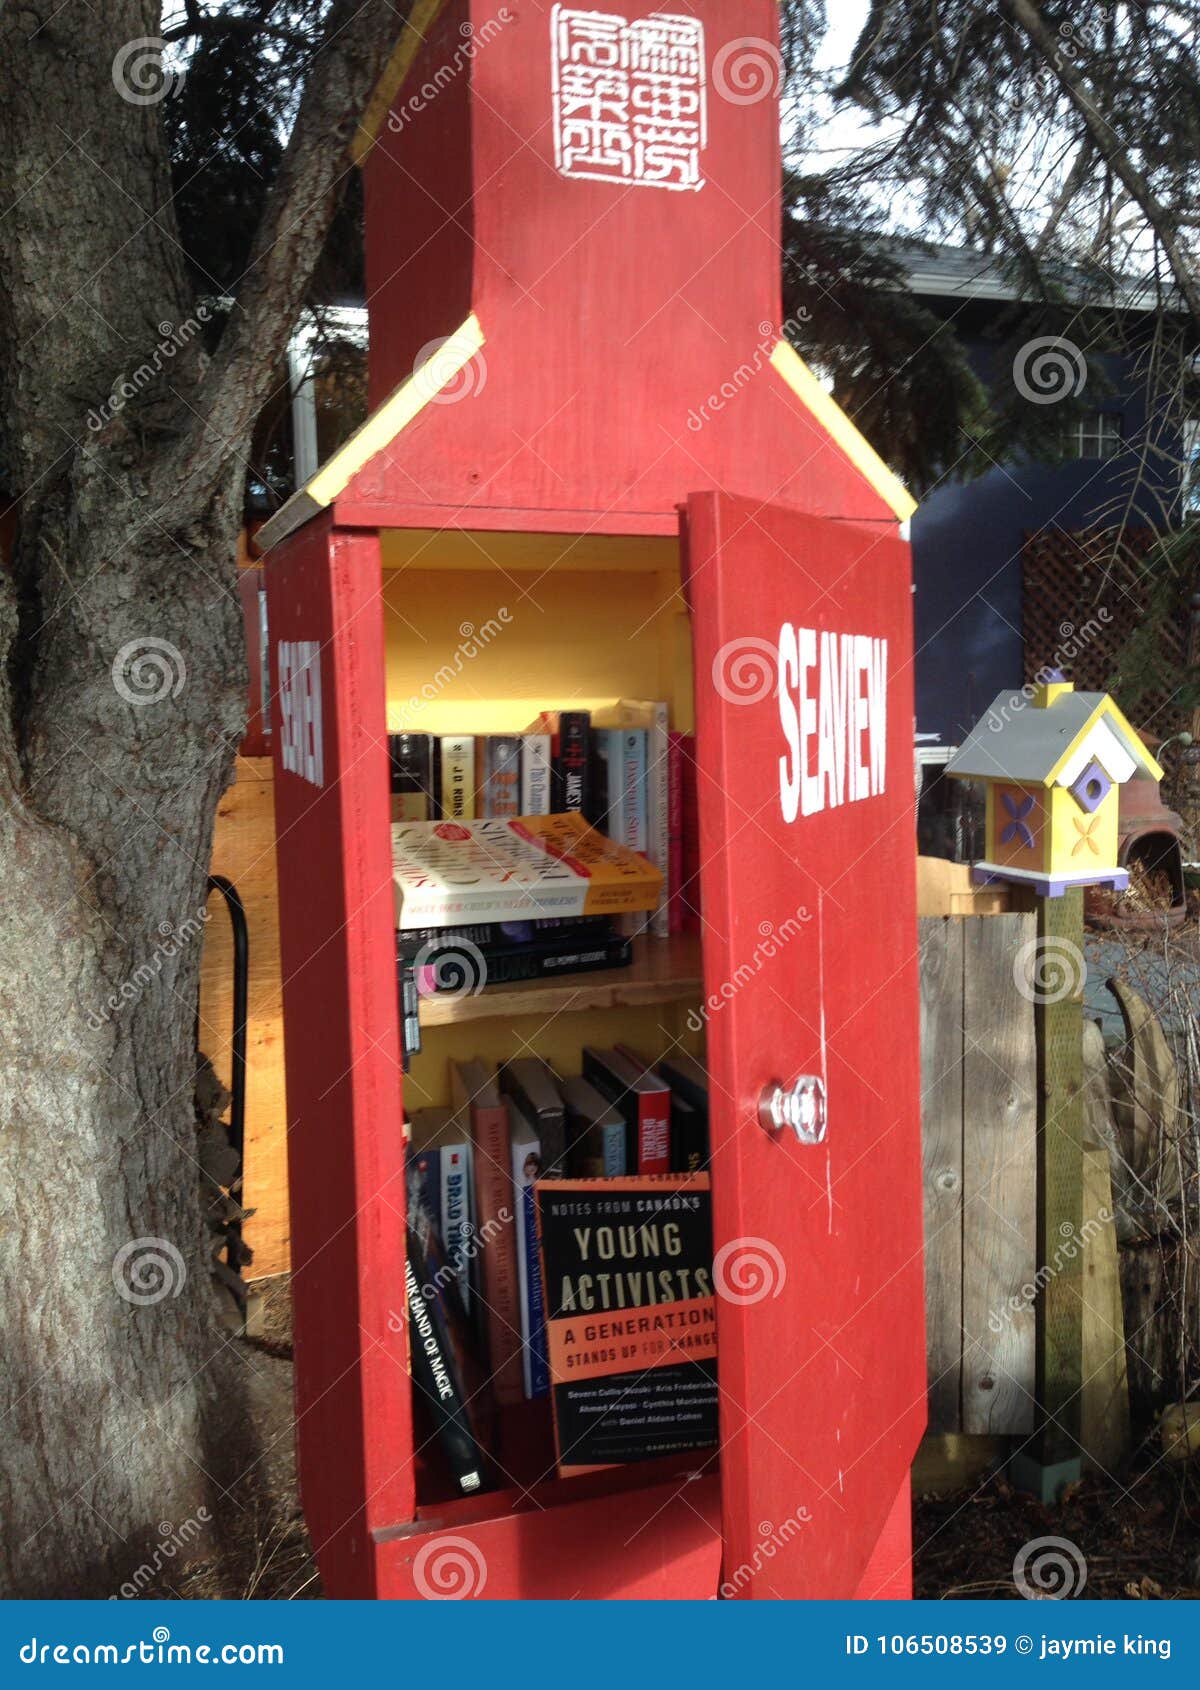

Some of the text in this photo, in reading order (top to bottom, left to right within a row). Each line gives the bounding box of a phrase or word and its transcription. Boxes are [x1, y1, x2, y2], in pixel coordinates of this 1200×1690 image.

[778, 622, 888, 824] SEAVIEW
[566, 771, 582, 804] JAMES
[447, 1173, 464, 1220] BRAD
[551, 1197, 701, 1216] NOTES FROM CANADA'S
[573, 1223, 682, 1261] YOUNG
[561, 1267, 713, 1312] ACTIVISTS
[410, 1296, 433, 1338] HAND
[564, 1329, 576, 1345] A
[584, 1307, 715, 1341] GENERATION
[423, 1337, 440, 1356] OF
[566, 1348, 617, 1368] STANDS
[621, 1345, 637, 1359] UP
[669, 1332, 718, 1351] CHANGE
[429, 1355, 454, 1401] MAGIC
